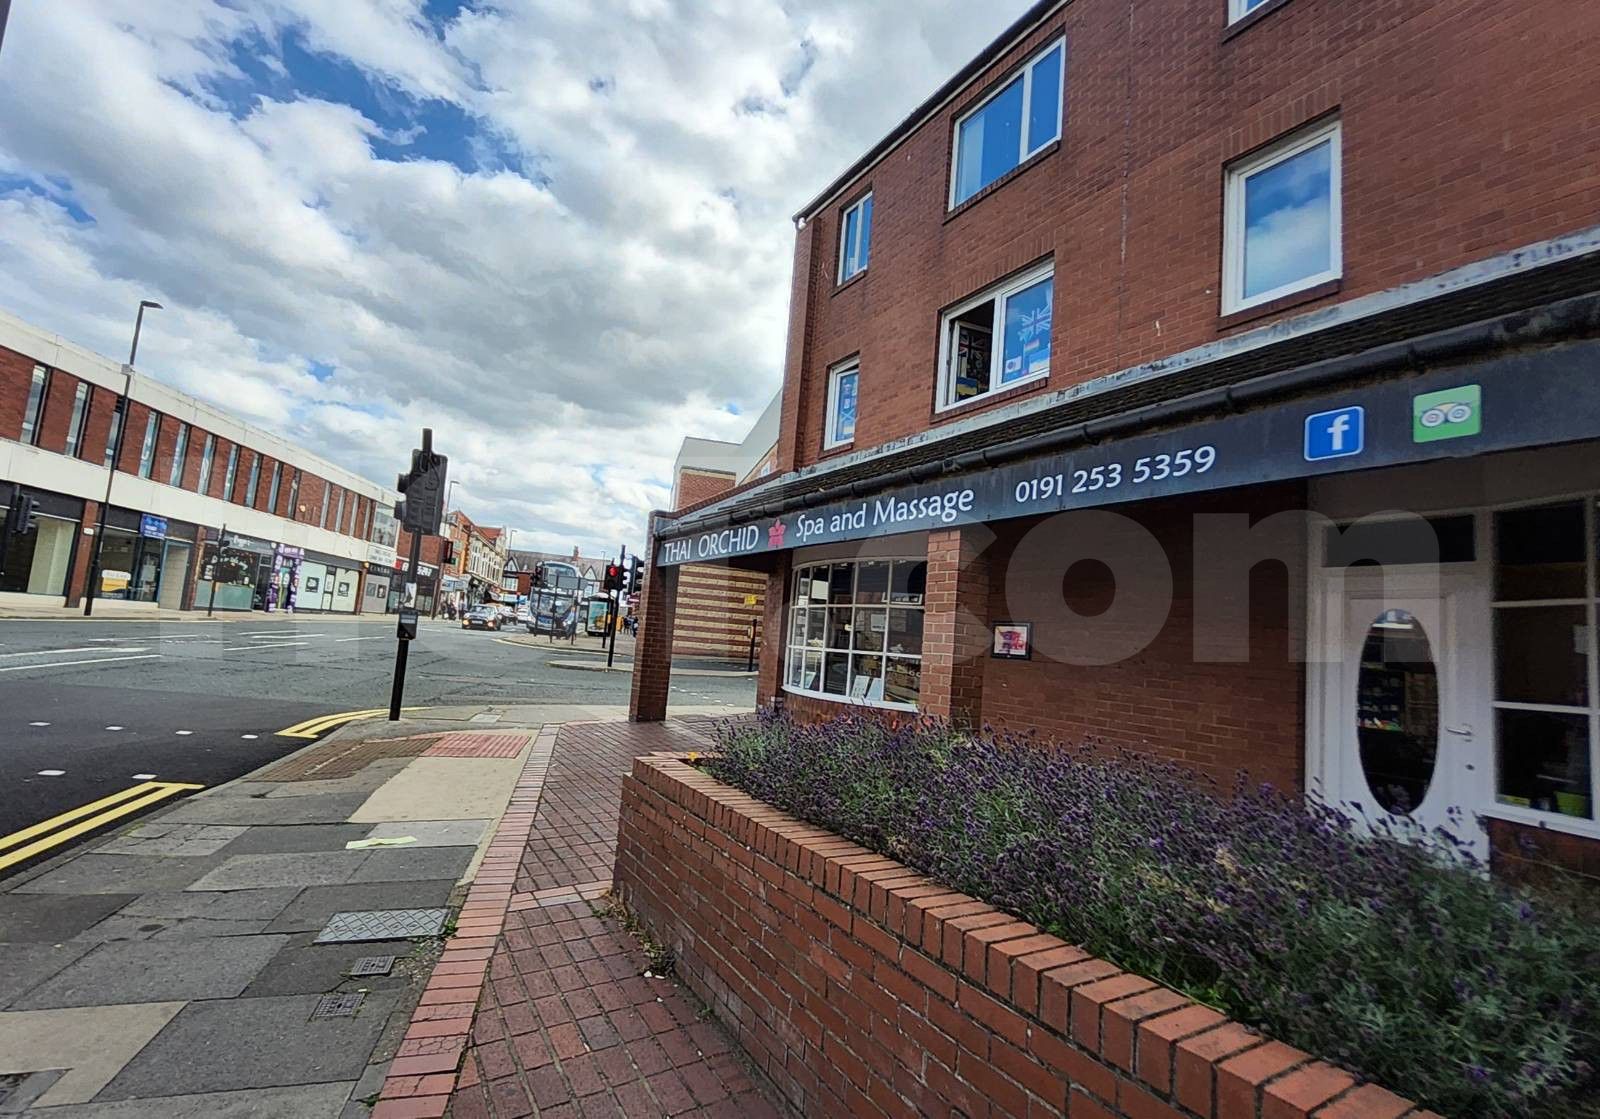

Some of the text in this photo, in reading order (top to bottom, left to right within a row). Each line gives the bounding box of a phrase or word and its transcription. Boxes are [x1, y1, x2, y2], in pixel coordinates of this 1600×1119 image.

[1327, 414, 1349, 451] f
[664, 446, 1216, 563] THAI ORCHID Spa and Massage 0191 253 5359
